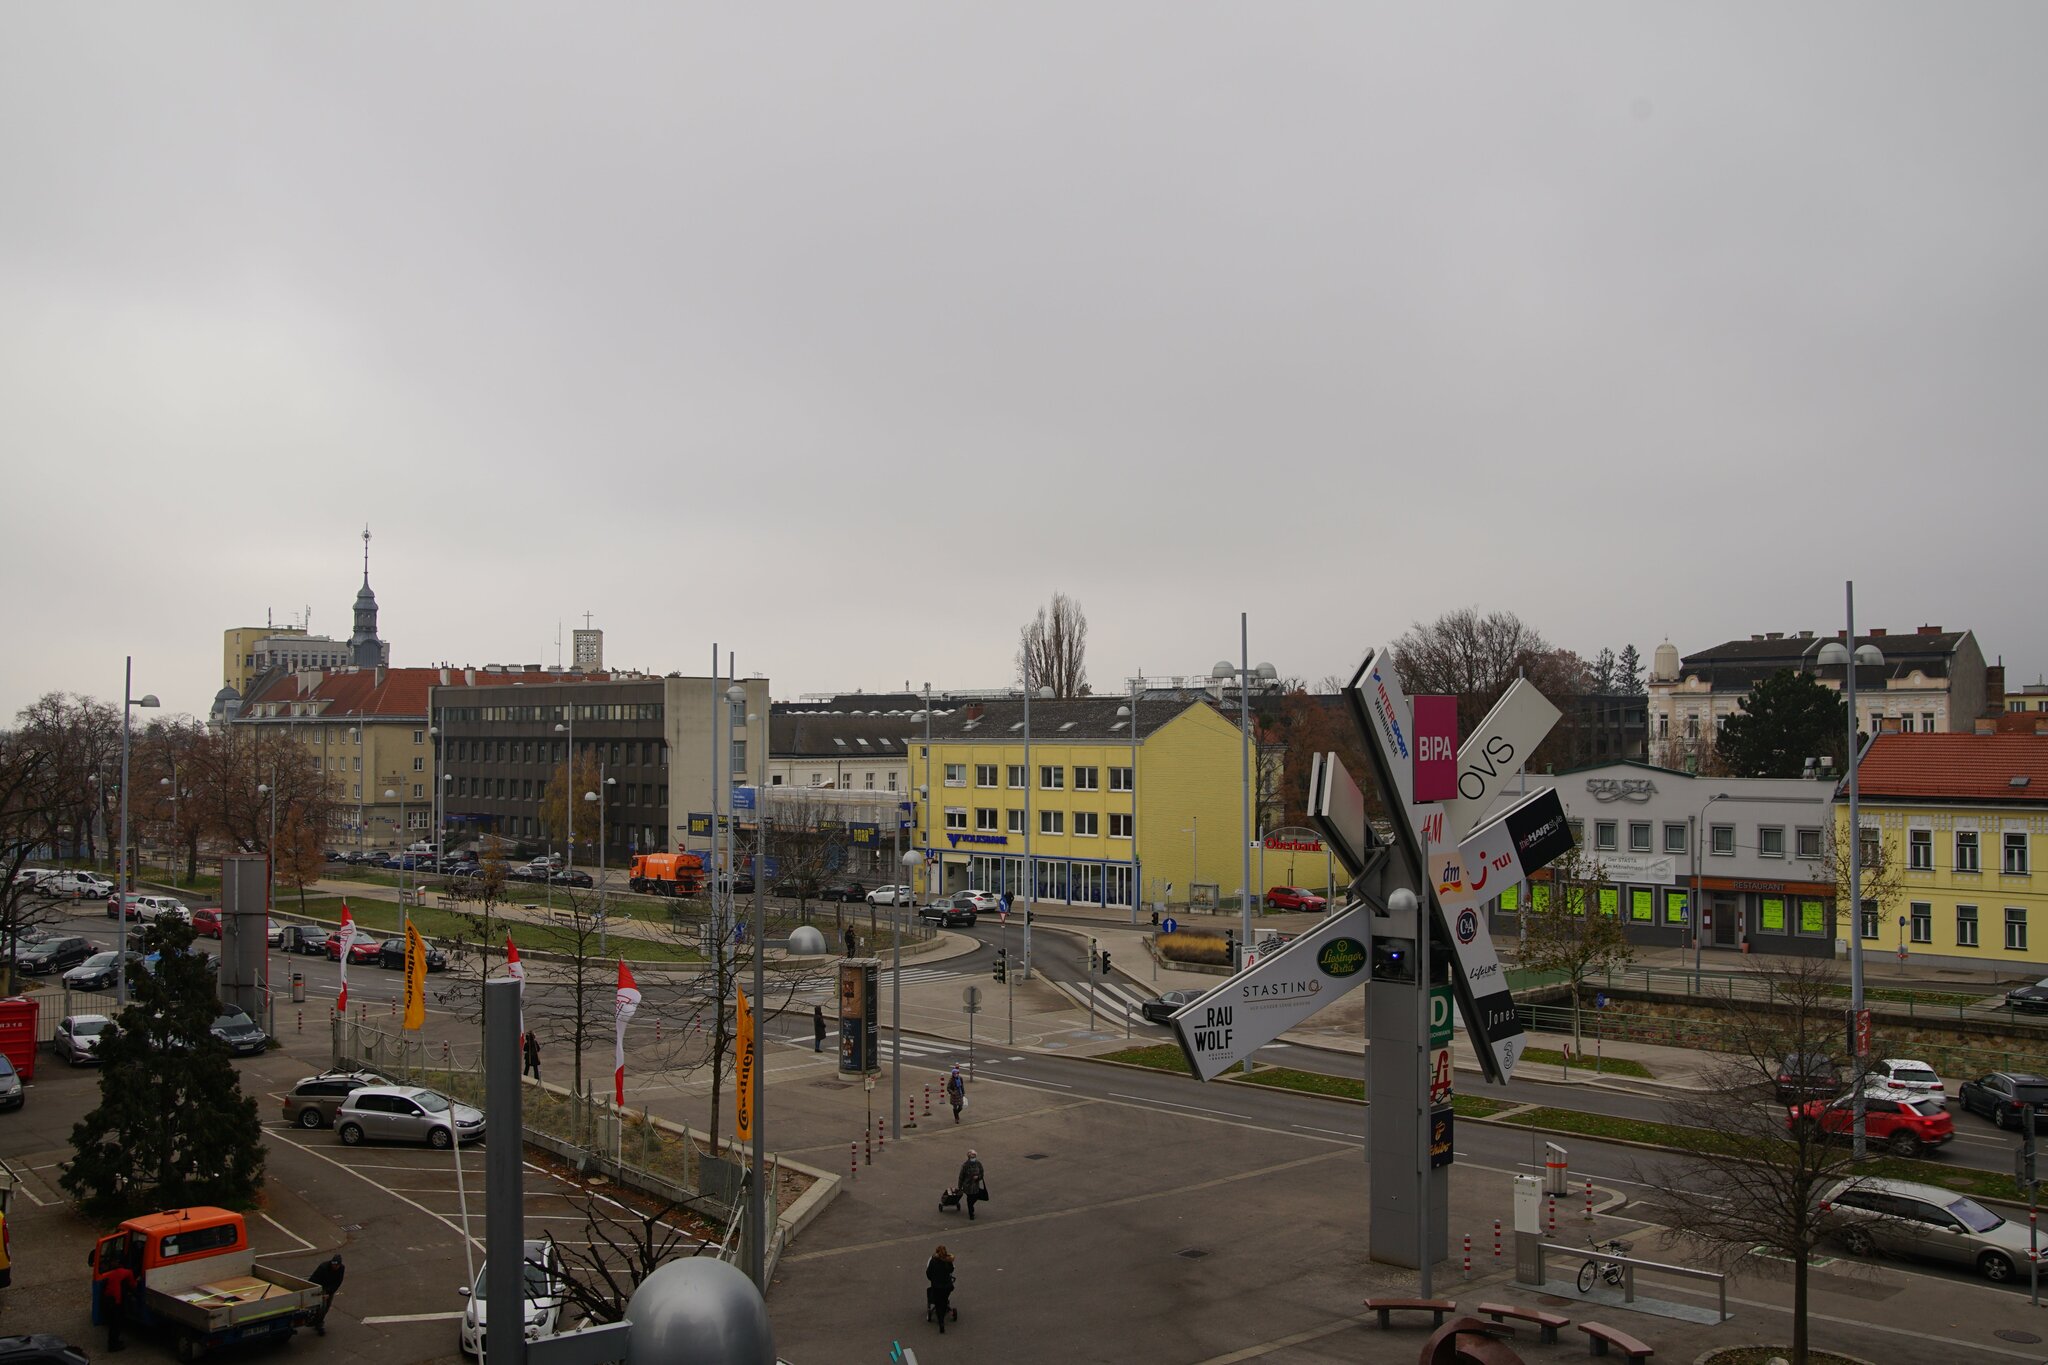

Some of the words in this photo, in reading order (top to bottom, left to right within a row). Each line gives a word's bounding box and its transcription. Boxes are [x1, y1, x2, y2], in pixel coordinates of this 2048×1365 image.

[1375, 697, 1398, 757] WINNINGER
[1378, 683, 1408, 760] INTERSPORT
[1419, 736, 1453, 762] BIPA
[1458, 736, 1514, 800] OVS
[1586, 778, 1659, 795] STASTA
[1265, 836, 1322, 851] Oberbank
[1443, 861, 1459, 882] dm
[1492, 852, 1512, 871] TUI
[1733, 881, 1784, 891] RESTAURANT
[1459, 917, 1475, 936] C&A
[1320, 948, 1364, 964] Liesinger
[1243, 979, 1321, 999] STASTINO
[1487, 1009, 1515, 1031] Jones
[1194, 1029, 1232, 1052] WOLF
[1503, 1041, 1514, 1069] 3
